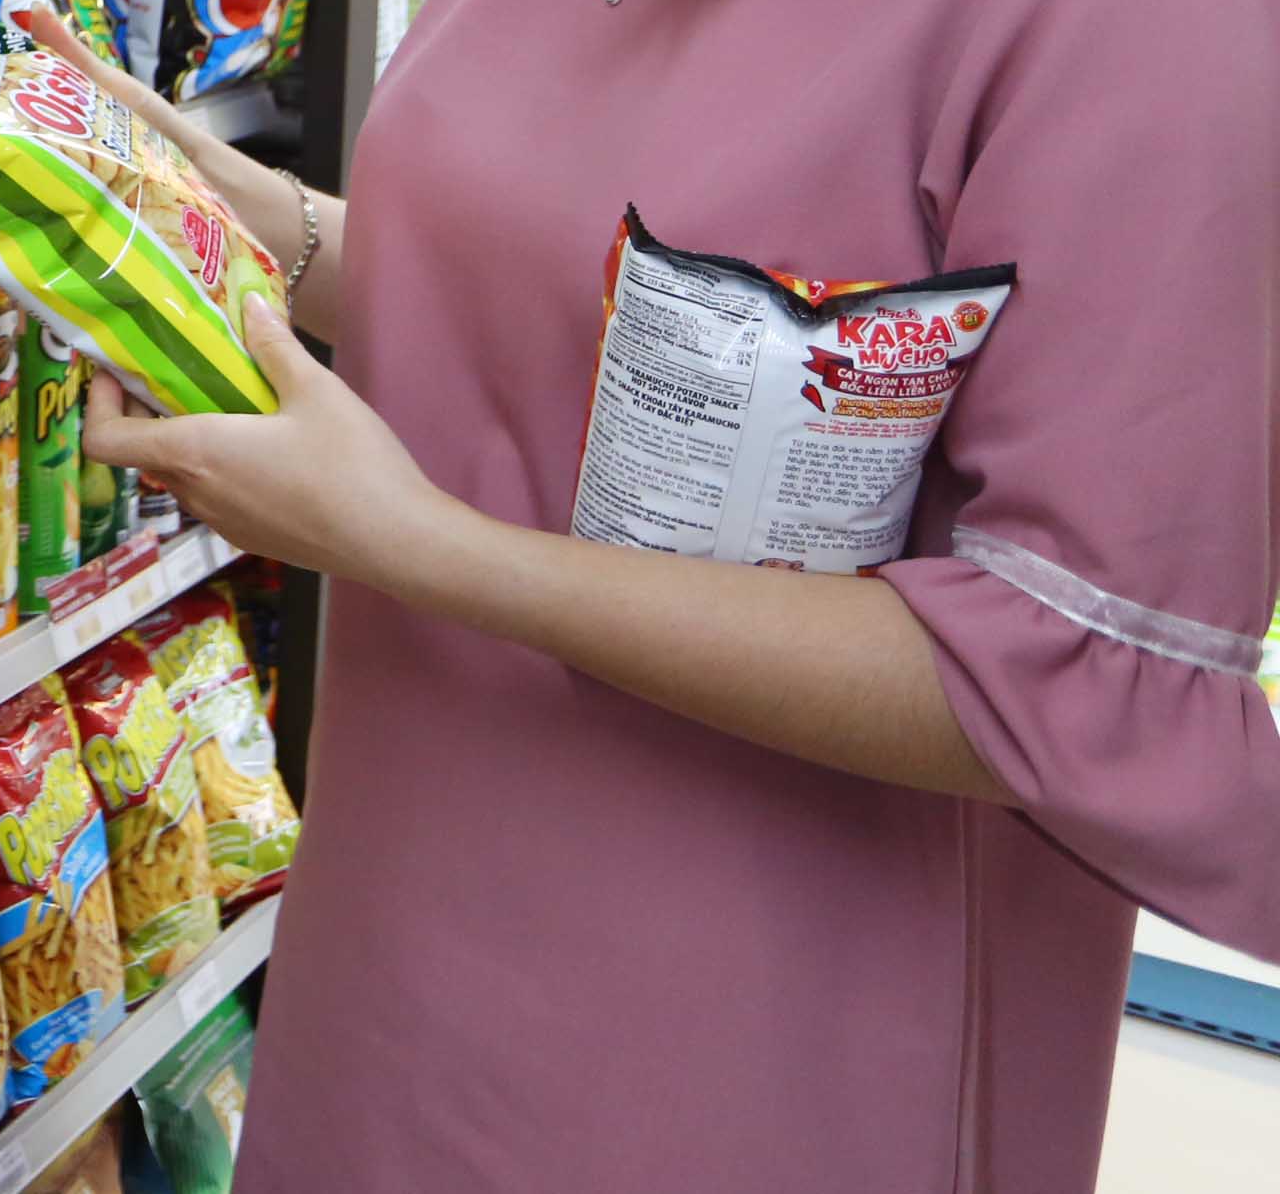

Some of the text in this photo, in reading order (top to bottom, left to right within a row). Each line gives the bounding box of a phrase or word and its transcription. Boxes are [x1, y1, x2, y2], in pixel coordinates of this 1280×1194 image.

[836, 315, 958, 349] KARA
[858, 346, 949, 371] MUCHO
[626, 364, 676, 393] KARAMUCHO
[676, 385, 710, 403] POTATO
[709, 395, 740, 412] SNACK
[631, 375, 707, 411] HOT SPICY FLAVOR
[837, 367, 861, 382] CAY
[864, 375, 899, 387] NGON
[617, 378, 641, 398] SNACK
[641, 391, 667, 408] KHOAI
[667, 399, 685, 414] TÂY
[684, 406, 741, 431] KARAMUCHO
[641, 402, 657, 417] CAY
[674, 412, 695, 428] BIỆT
